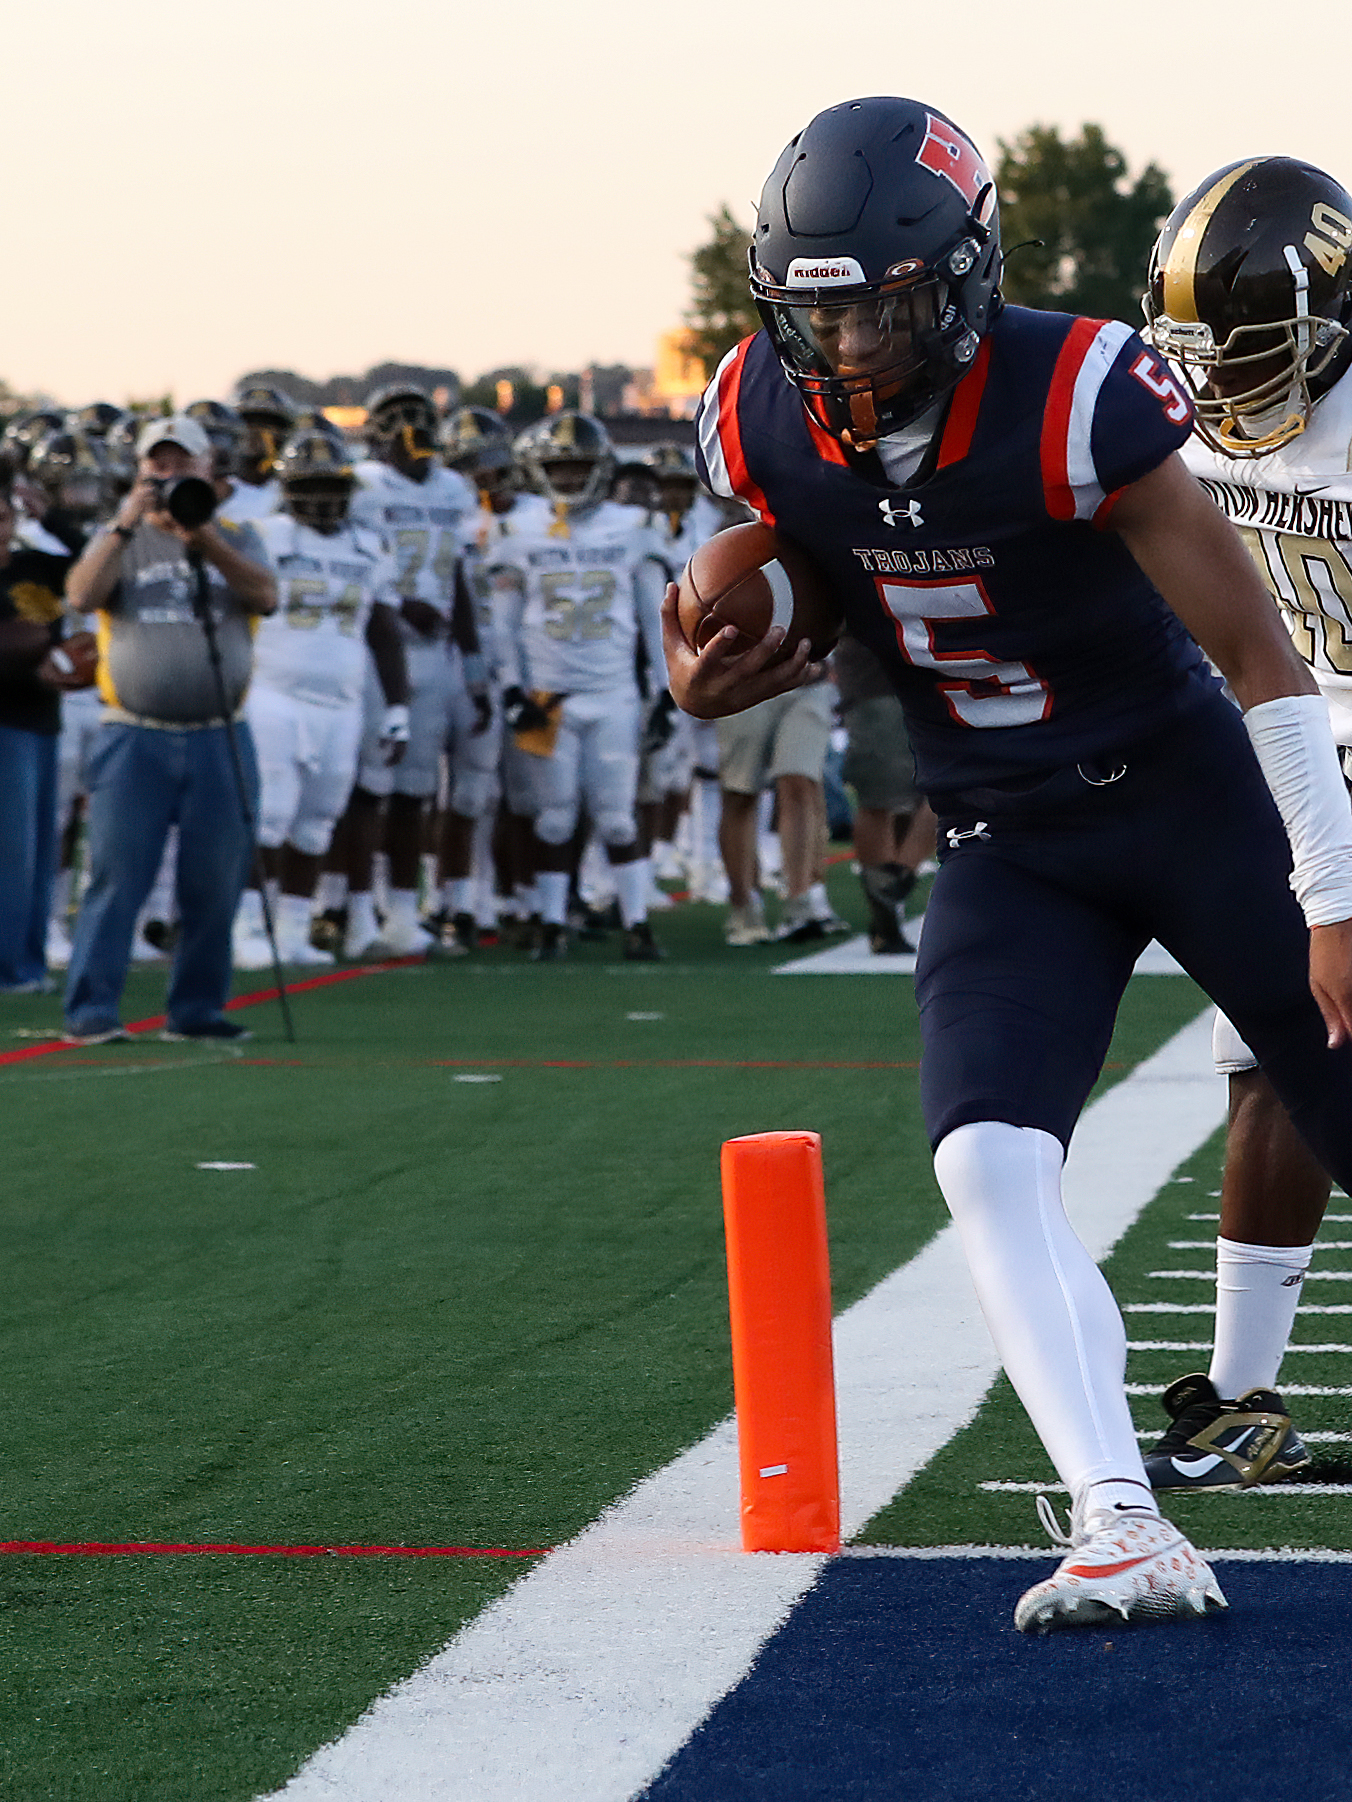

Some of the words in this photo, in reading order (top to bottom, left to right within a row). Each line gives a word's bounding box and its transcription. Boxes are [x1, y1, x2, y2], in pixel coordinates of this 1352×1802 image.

[1128, 351, 1193, 426] 5
[852, 547, 995, 573] TROJANS
[540, 571, 616, 641] 52
[873, 574, 1055, 729] 5
